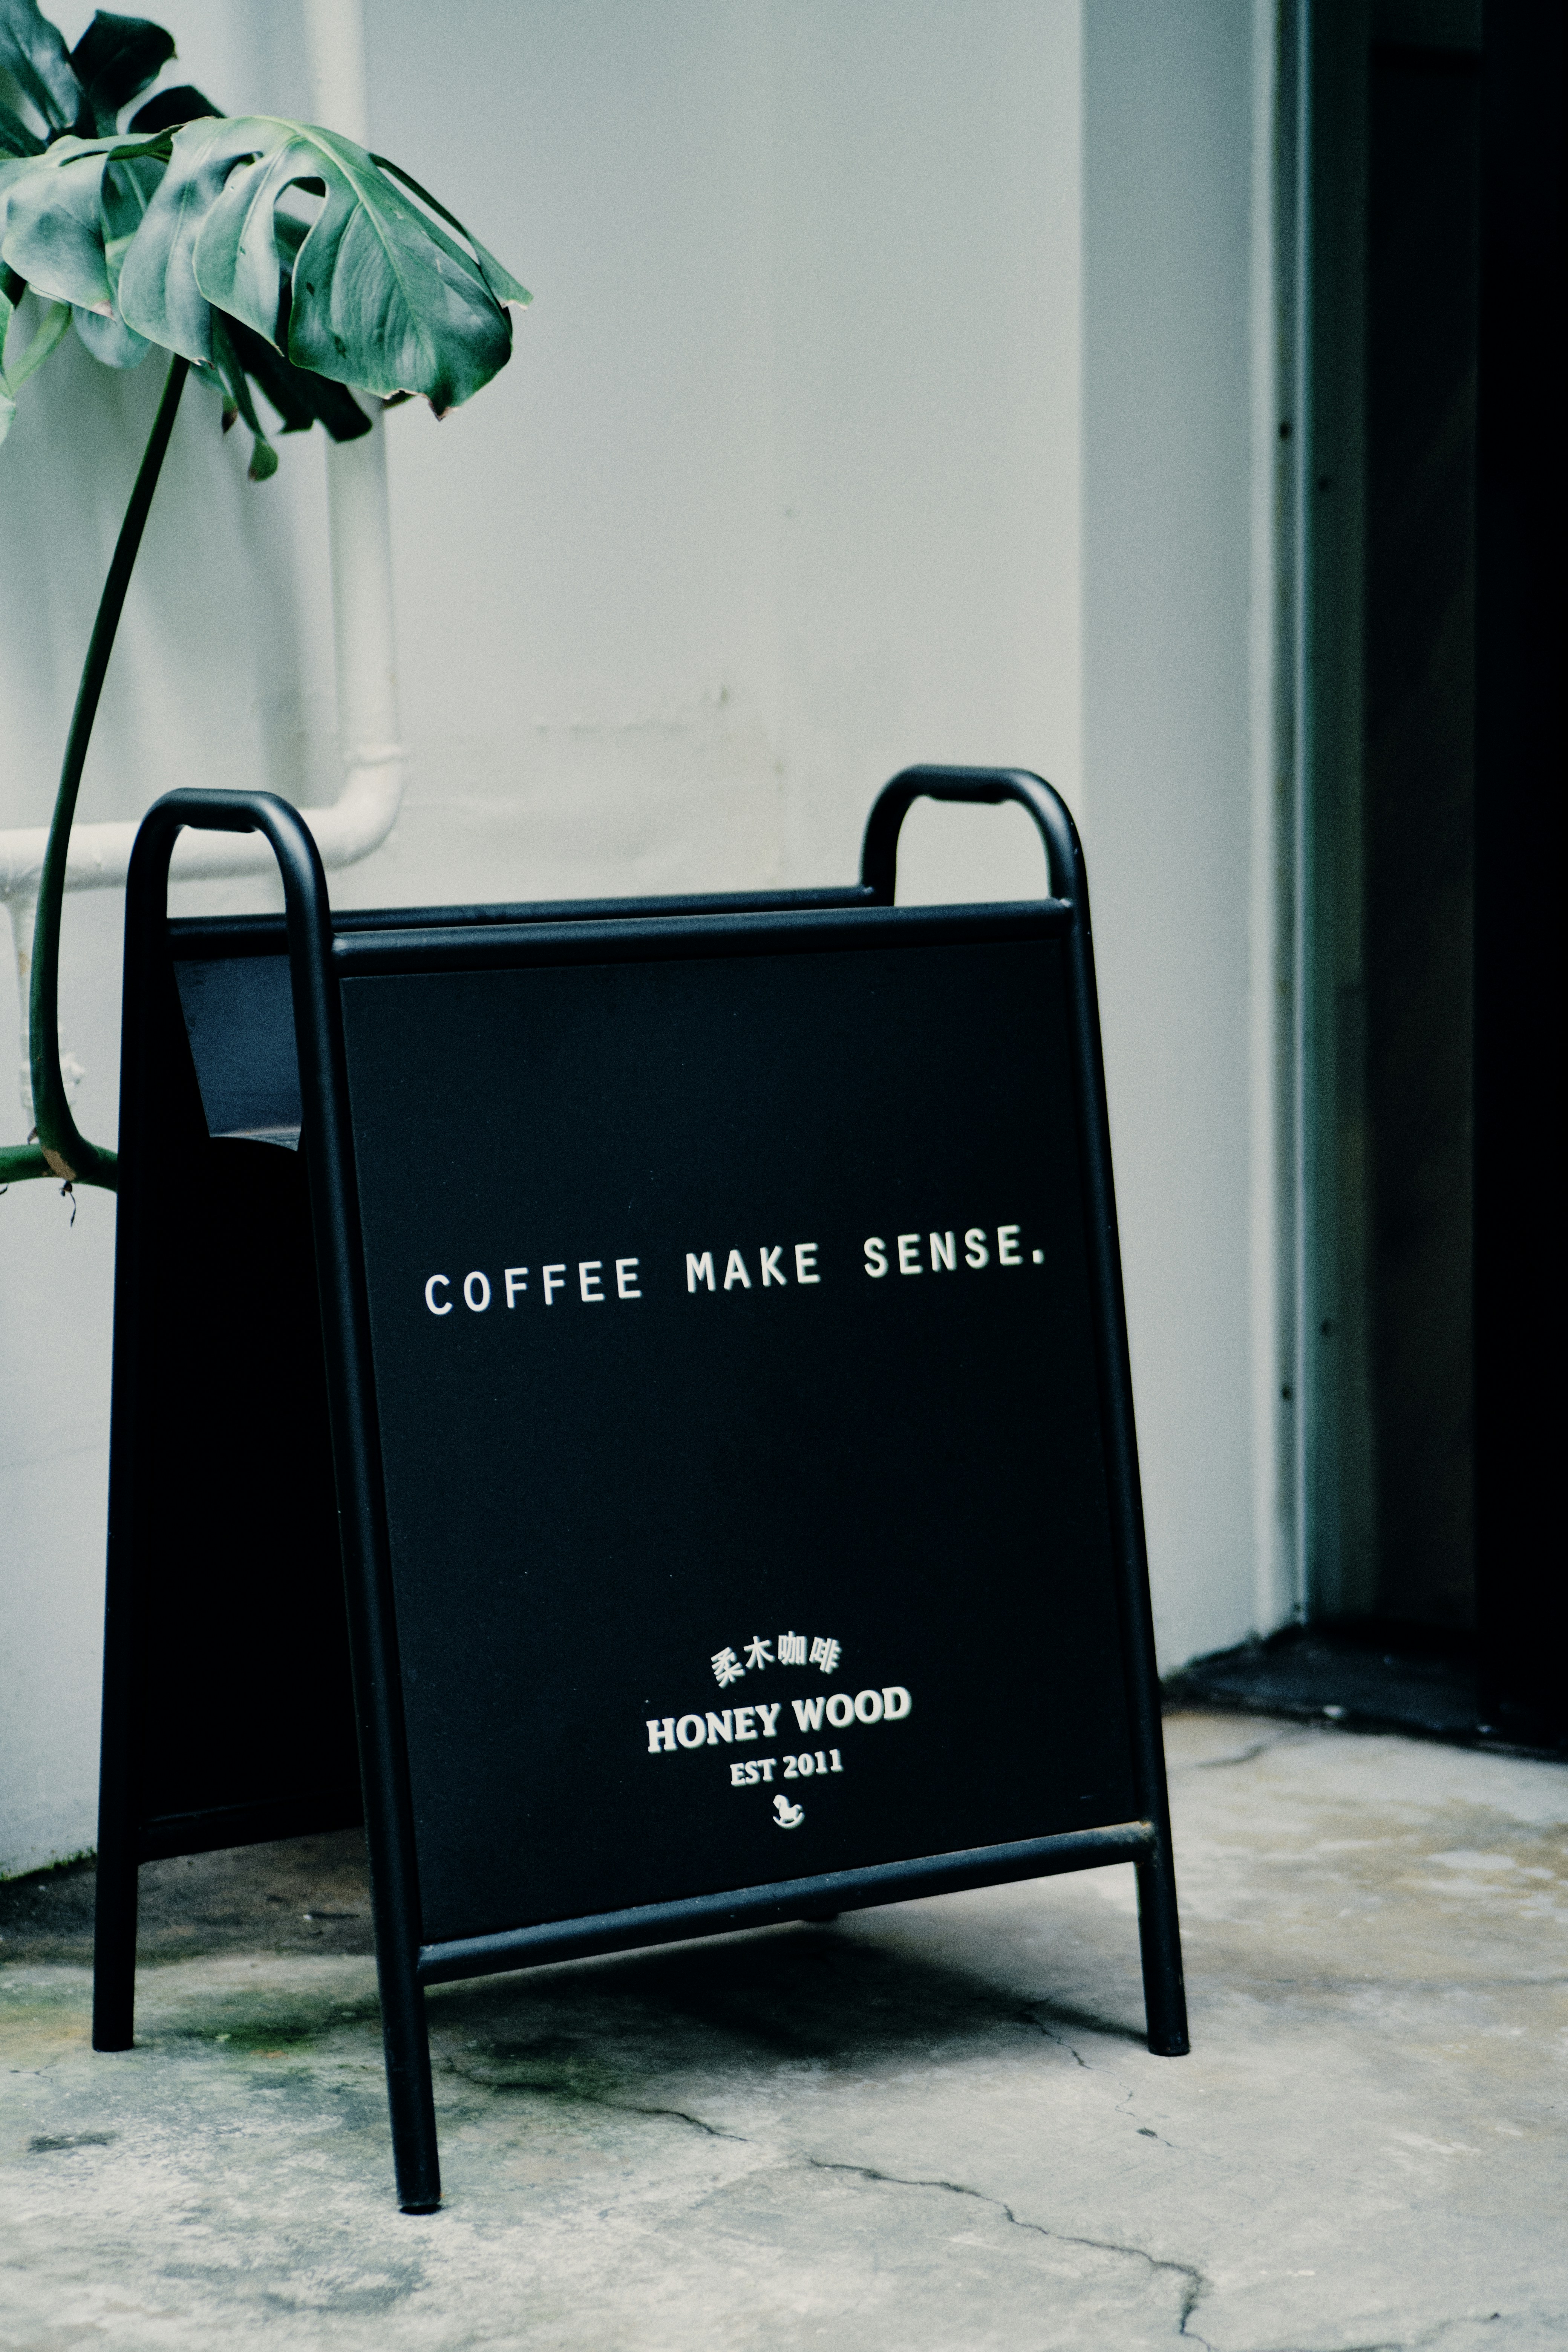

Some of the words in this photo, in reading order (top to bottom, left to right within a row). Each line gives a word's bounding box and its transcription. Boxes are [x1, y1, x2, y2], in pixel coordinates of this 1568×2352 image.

[424, 1258, 642, 1315] COFFEE
[686, 1243, 821, 1293] MAKE
[864, 1225, 1044, 1278] SENSE.
[710, 1631, 842, 1688] 柔木咖啡
[646, 1703, 781, 1753] HONEY
[791, 1686, 912, 1732] WOOD
[730, 1758, 777, 1786] EST
[782, 1749, 843, 1779] 2011
